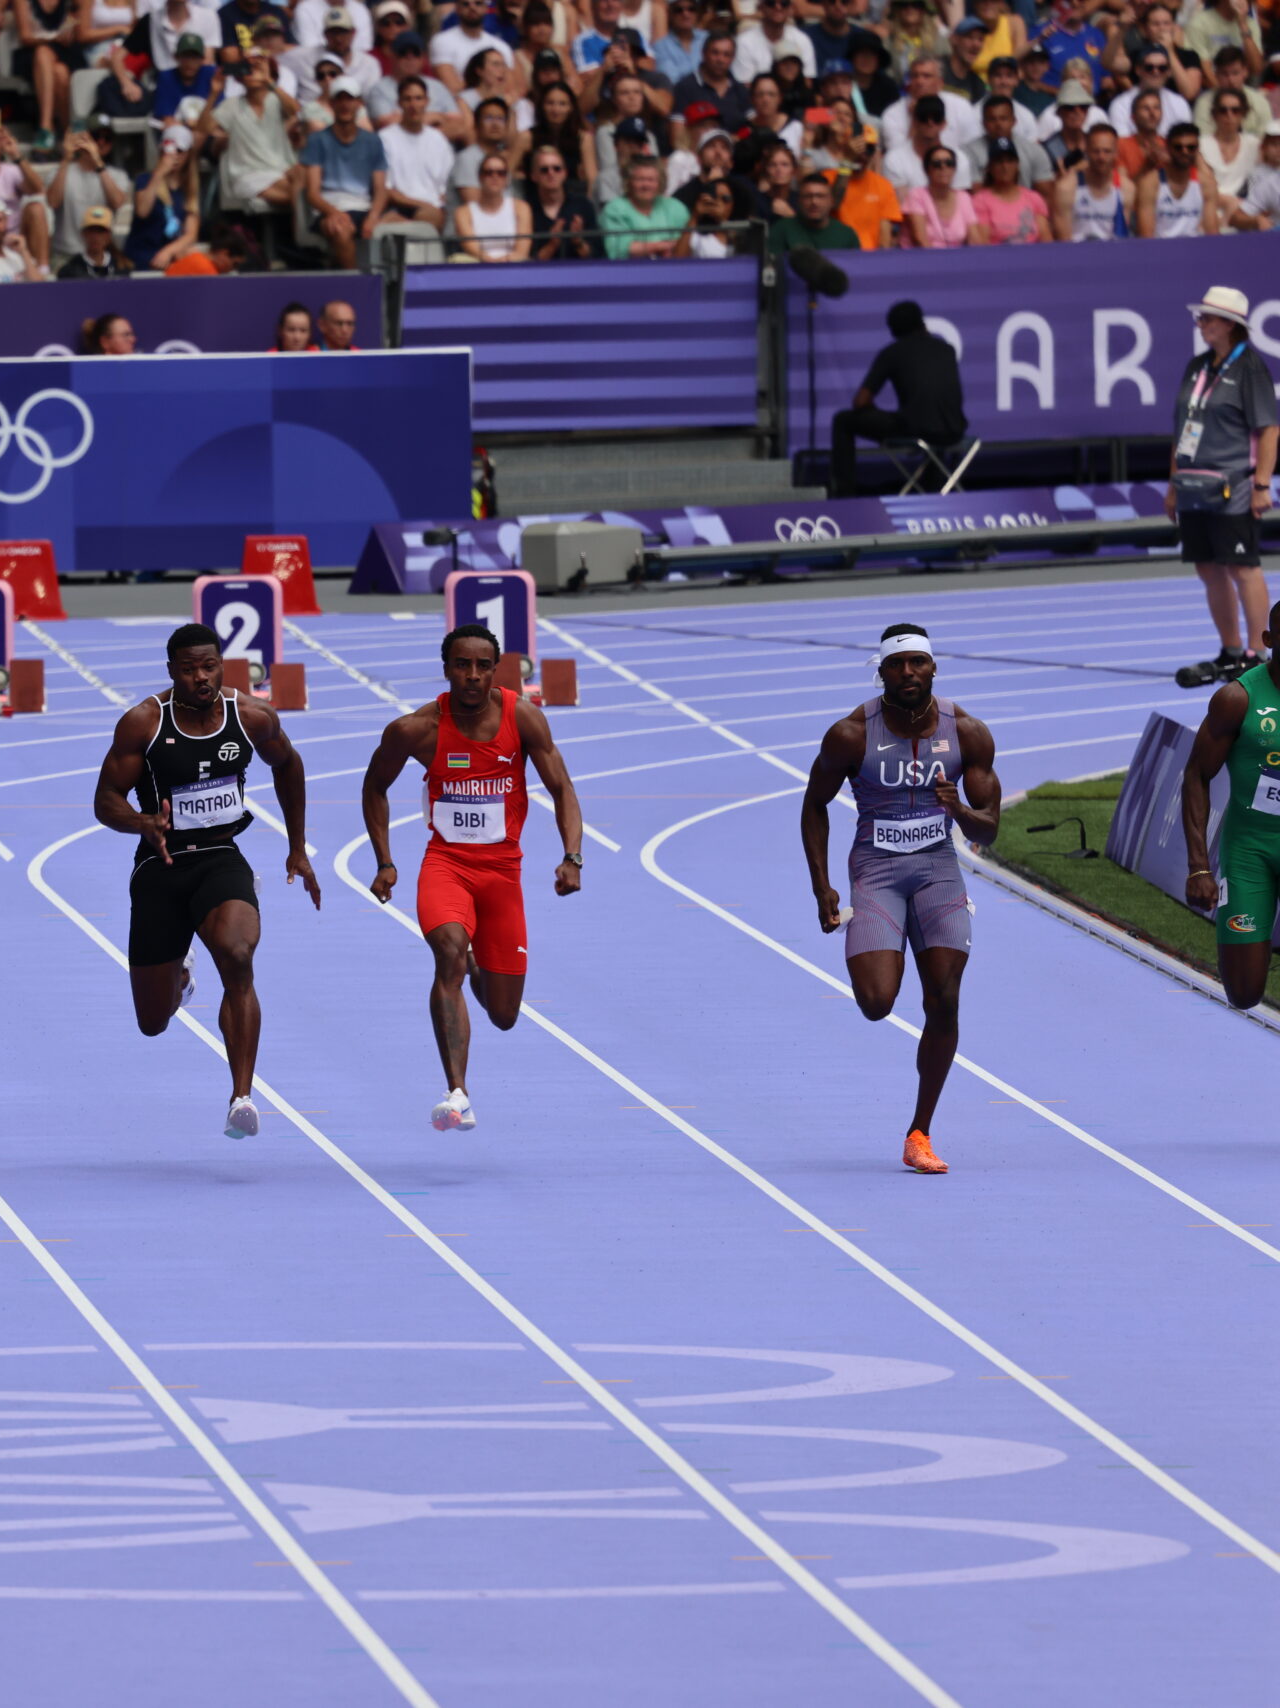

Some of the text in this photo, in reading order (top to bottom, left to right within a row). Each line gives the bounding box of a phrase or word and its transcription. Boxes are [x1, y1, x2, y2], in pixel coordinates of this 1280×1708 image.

[214, 601, 263, 664] 2
[476, 594, 505, 655] 1
[879, 760, 947, 787] USA
[442, 777, 513, 796] MAURITIUS
[179, 791, 237, 815] MATADI
[453, 811, 486, 828] BIBI
[876, 822, 945, 844] BEDNAREK
